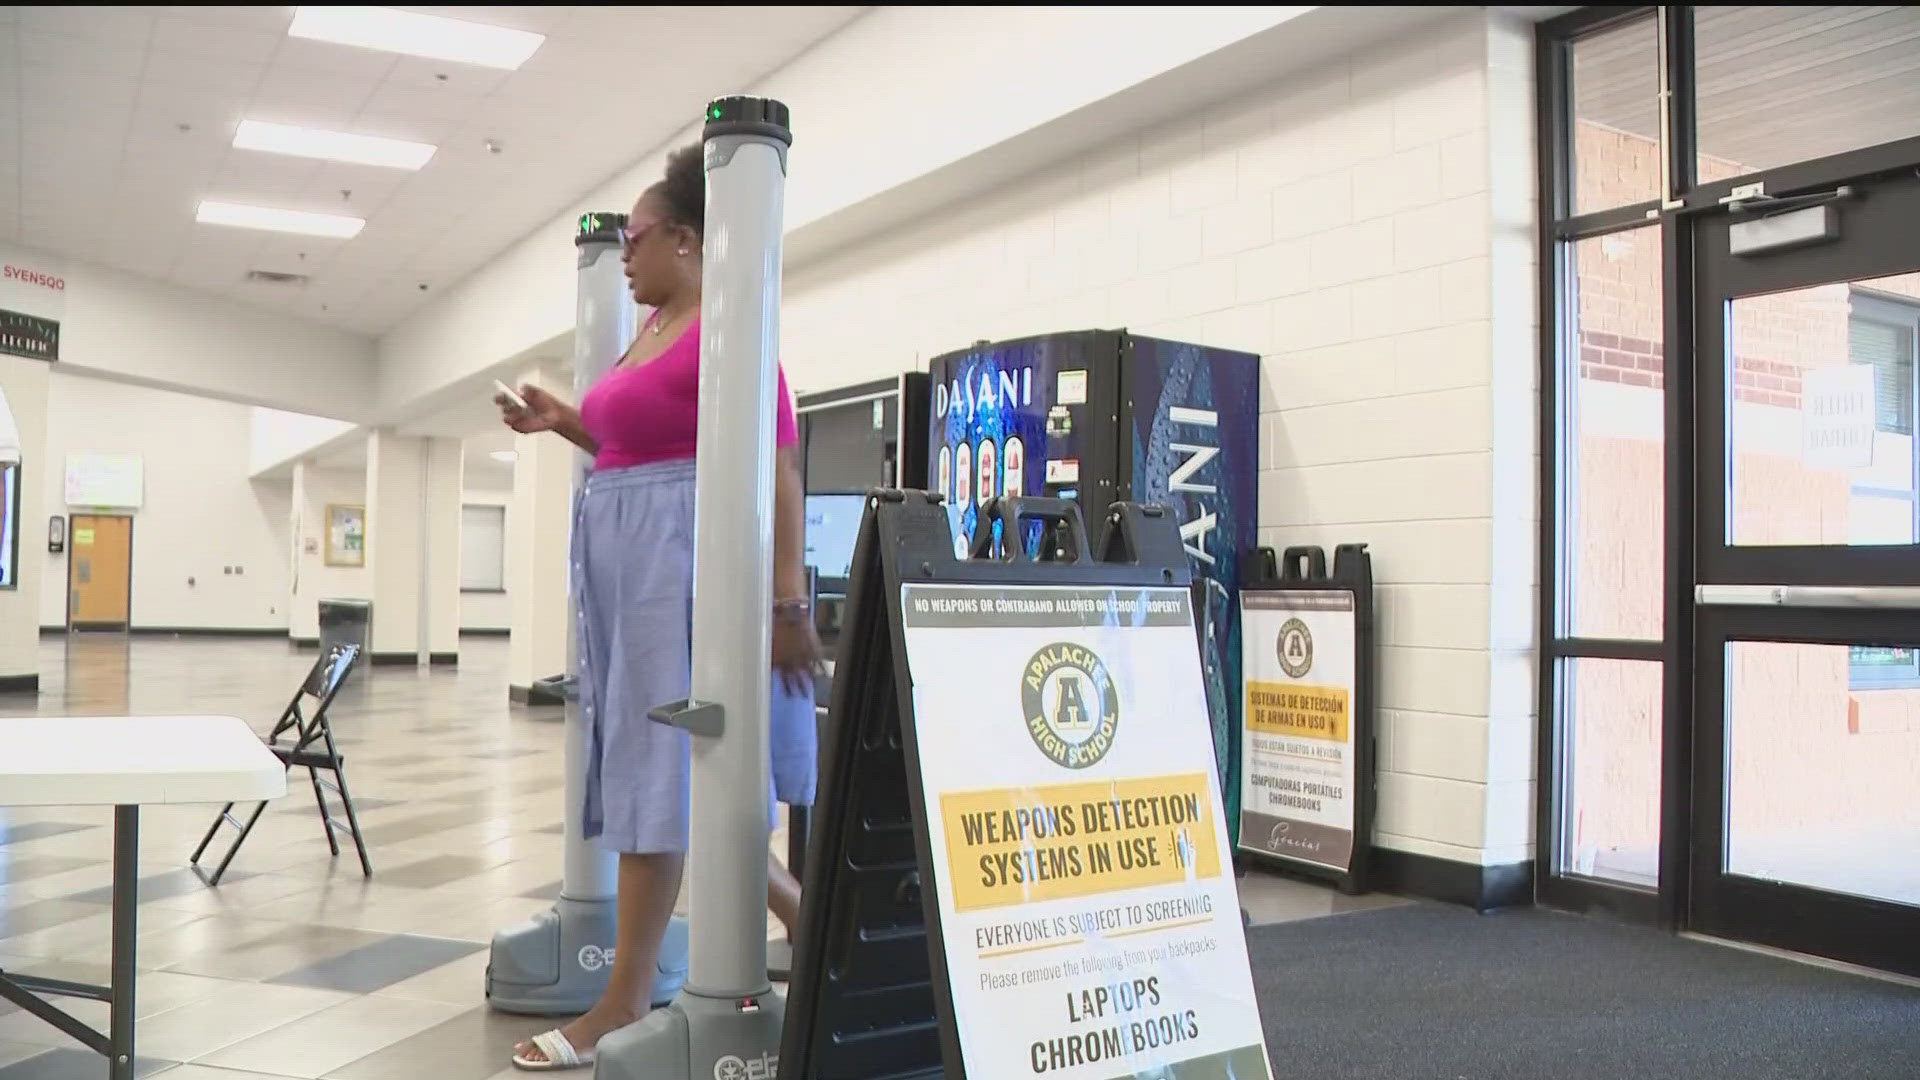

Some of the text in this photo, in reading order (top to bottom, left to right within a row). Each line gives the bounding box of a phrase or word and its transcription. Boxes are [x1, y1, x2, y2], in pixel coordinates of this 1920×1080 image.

[3, 264, 65, 291] SYENSQO
[937, 365, 1032, 424] DASANI
[1168, 406, 1220, 566] ANI
[914, 598, 929, 613] NO
[930, 598, 978, 613] WEAPONS
[980, 598, 995, 613] OR
[995, 599, 1054, 614] CONTRABAND
[1056, 599, 1096, 613] ALLOWED
[1095, 599, 1108, 613] ON
[1026, 645, 1111, 692] APALACHE
[1055, 675, 1091, 729] A
[1251, 690, 1286, 708] SISTEMAS
[1288, 694, 1298, 709] DE
[1255, 709, 1325, 730] DE ARMAS EN USO
[1030, 712, 1115, 765] HIGH SCHOOL
[1251, 773, 1302, 793] COMPUTADORAS
[1268, 791, 1321, 812] CHROMEBOOKS
[960, 792, 1199, 847] WEAPONS DETECTION
[979, 836, 1161, 888] SYSTEMS IN USE
[976, 894, 1213, 949] EVERYONE IS SUBJECT TO SCREENING
[980, 972, 1018, 991] Please
[1021, 965, 1061, 984] remove
[1063, 960, 1080, 977] the
[1124, 950, 1147, 967] from
[1067, 975, 1161, 1023] LAPTOPS
[1030, 1009, 1199, 1074] CHROMEBOOKS
